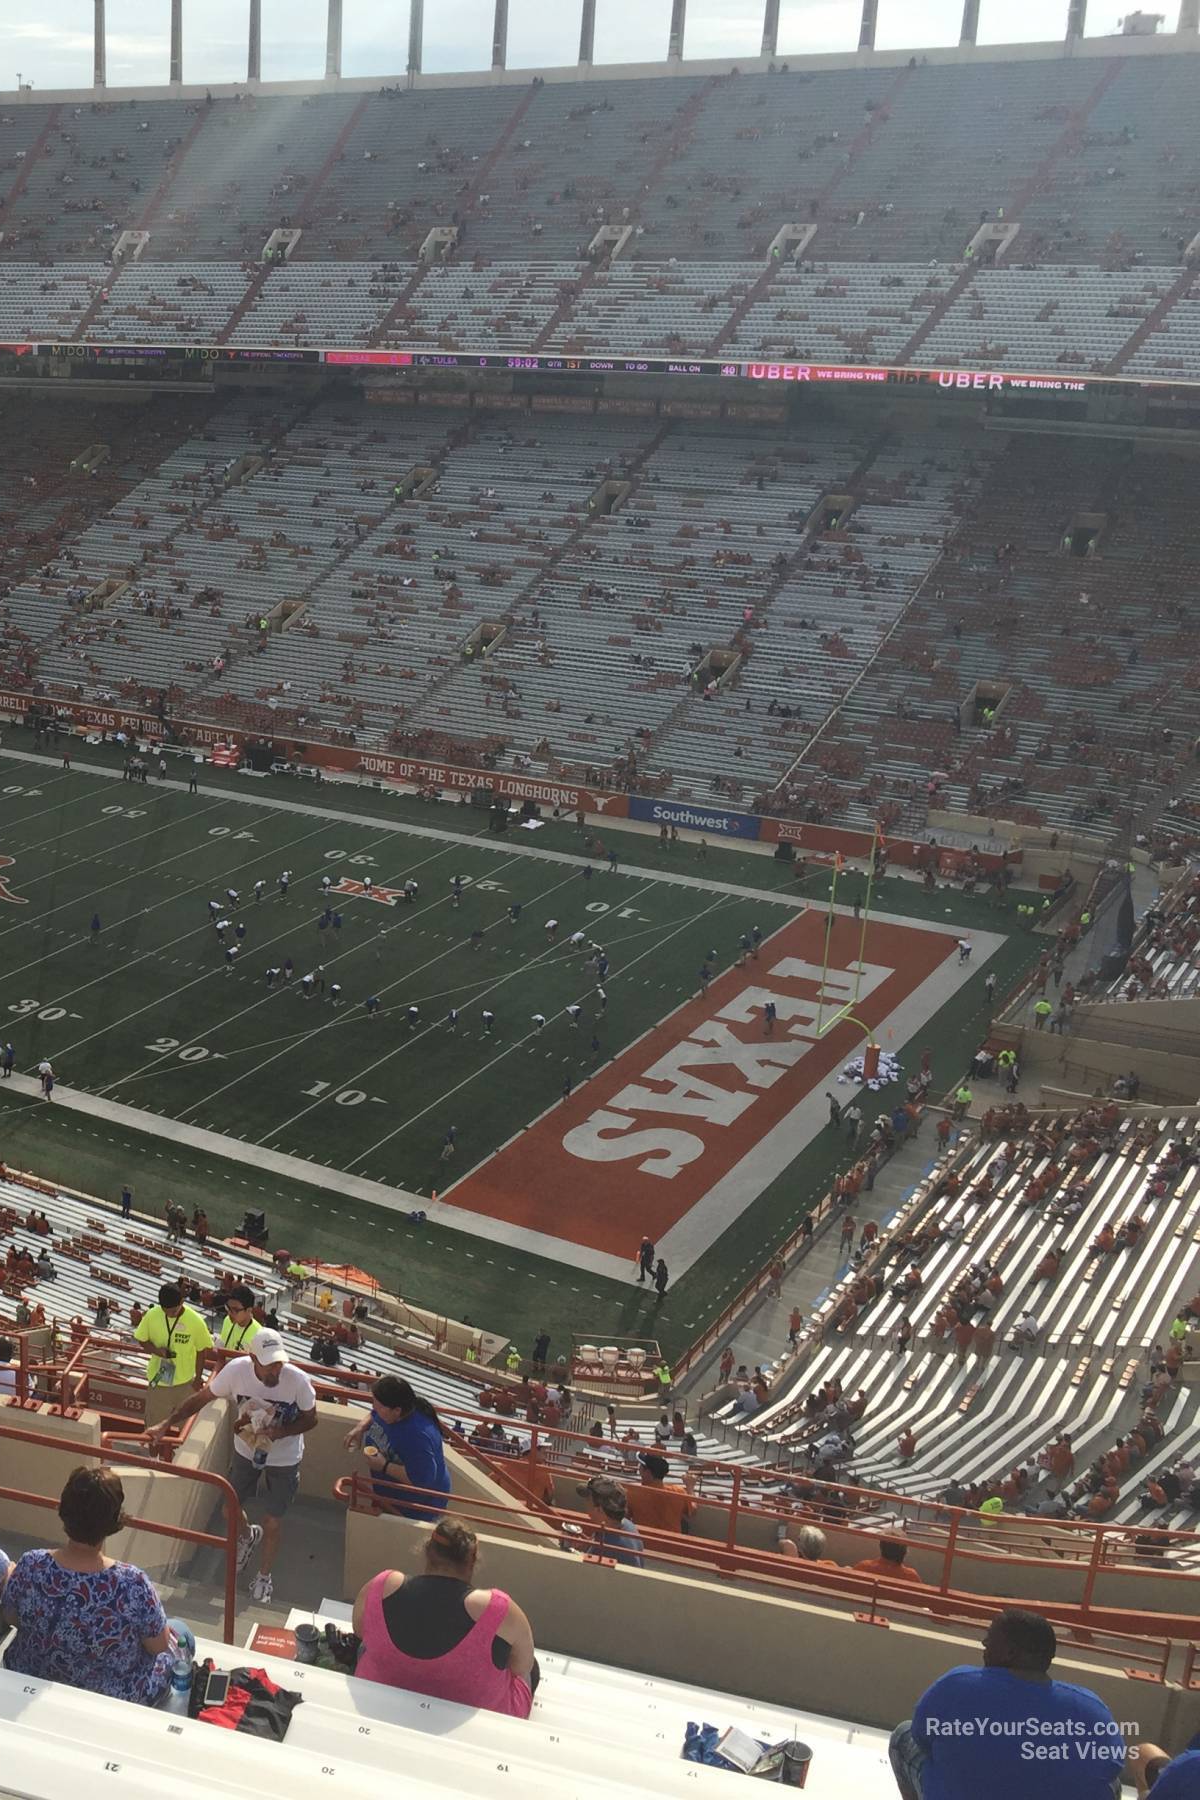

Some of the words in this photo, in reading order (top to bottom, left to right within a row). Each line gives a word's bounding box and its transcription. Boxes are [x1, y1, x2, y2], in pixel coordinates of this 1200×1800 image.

[668, 364, 687, 372] BALL
[689, 365, 701, 373] ON
[722, 365, 736, 375] 40
[752, 364, 811, 381] UBER
[816, 370, 832, 378] WE
[833, 371, 863, 380] BRING
[865, 372, 884, 381] THE
[938, 372, 1004, 390] UBER
[1029, 380, 1061, 389] BRING
[1063, 382, 1086, 391] THE
[360, 756, 396, 775] HOME
[400, 762, 416, 777] OF
[419, 768, 446, 784] THE
[449, 772, 494, 790] TEXAS
[498, 779, 579, 805] LONGHORNS
[2, 785, 43, 798] 40
[101, 805, 148, 819] 50
[653, 806, 729, 831] Southwest
[208, 826, 254, 841] 40
[585, 902, 640, 920] 10
[7, 999, 67, 1021] 30
[144, 1037, 211, 1061] 20
[562, 956, 896, 1179] TEXAS
[301, 1081, 368, 1106] 10
[123, 1398, 141, 1410] 123
[294, 1671, 304, 1679] 20
[358, 1726, 371, 1735] 20
[104, 1762, 120, 1772] 21
[321, 1766, 335, 1775] 20
